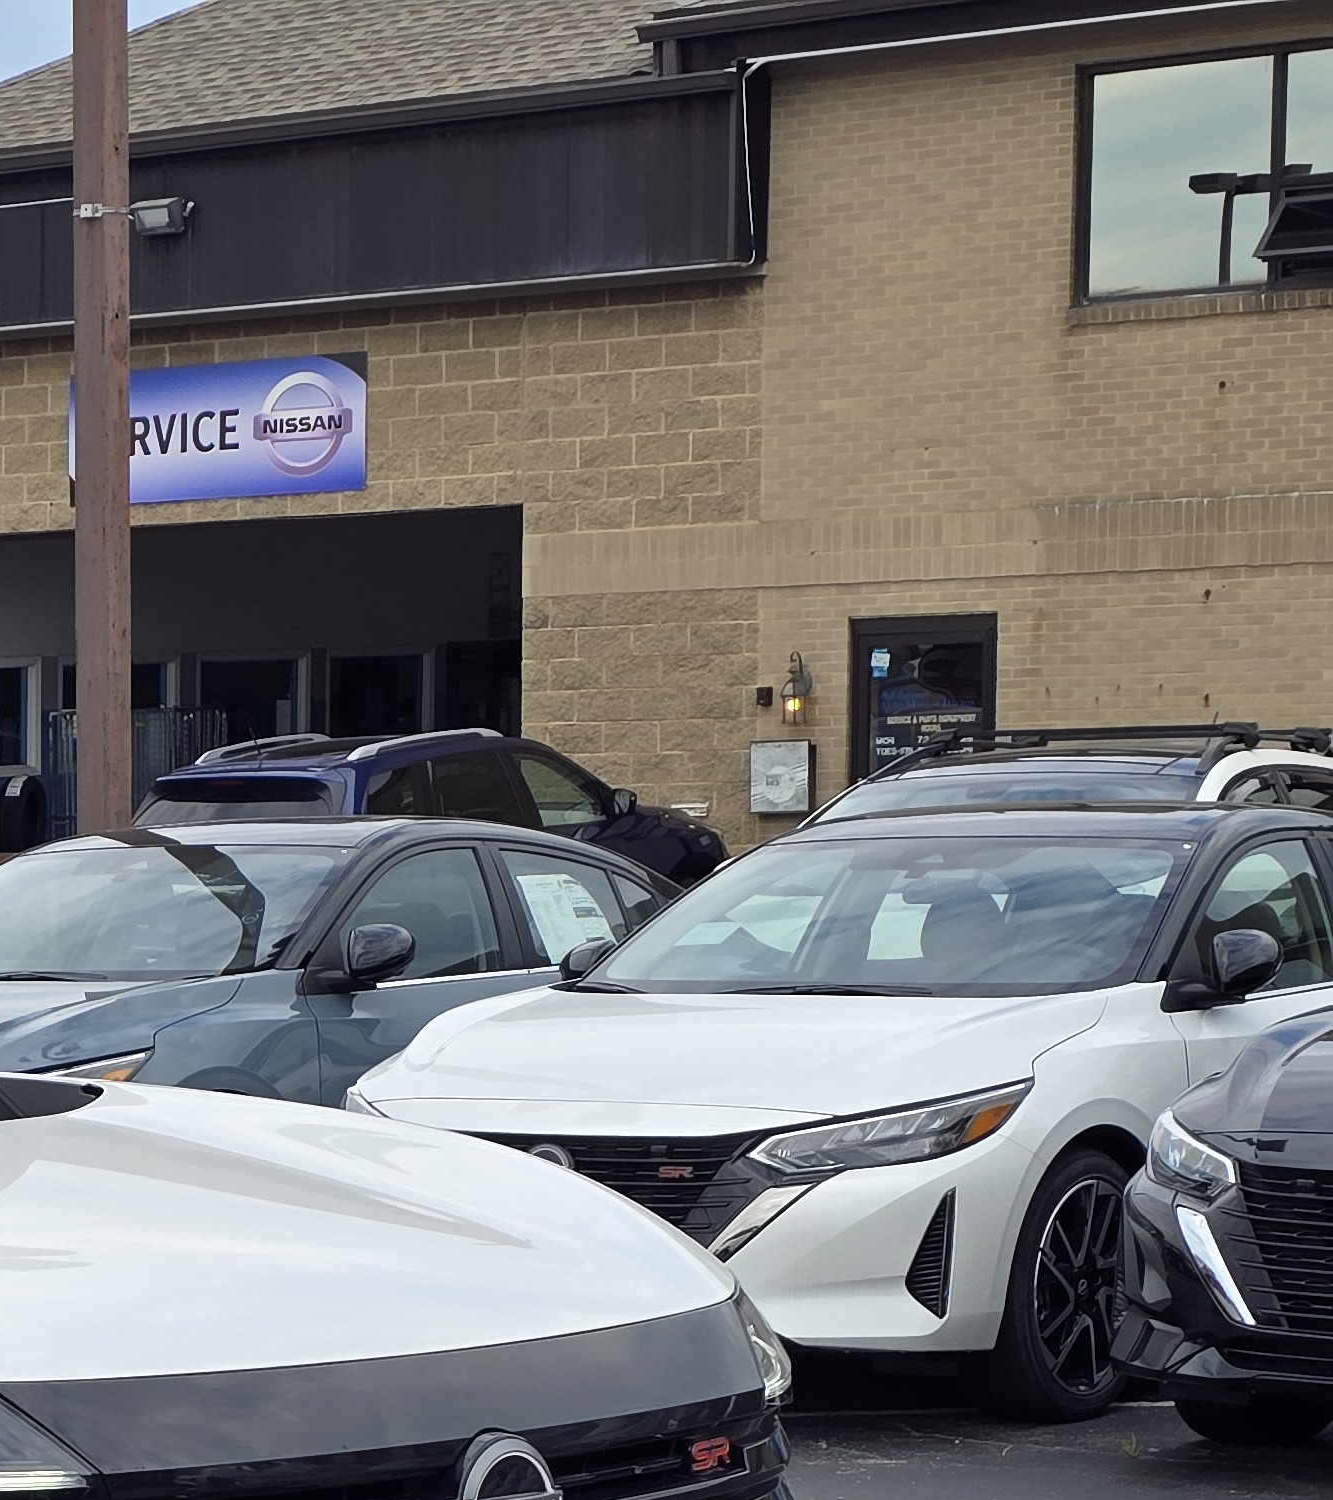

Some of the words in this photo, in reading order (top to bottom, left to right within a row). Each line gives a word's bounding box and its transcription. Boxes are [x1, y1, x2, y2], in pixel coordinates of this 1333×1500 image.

[130, 408, 240, 457] RVICE
[262, 413, 343, 435] NISSAN
[658, 1165, 694, 1178] SR
[691, 1436, 731, 1471] SR
